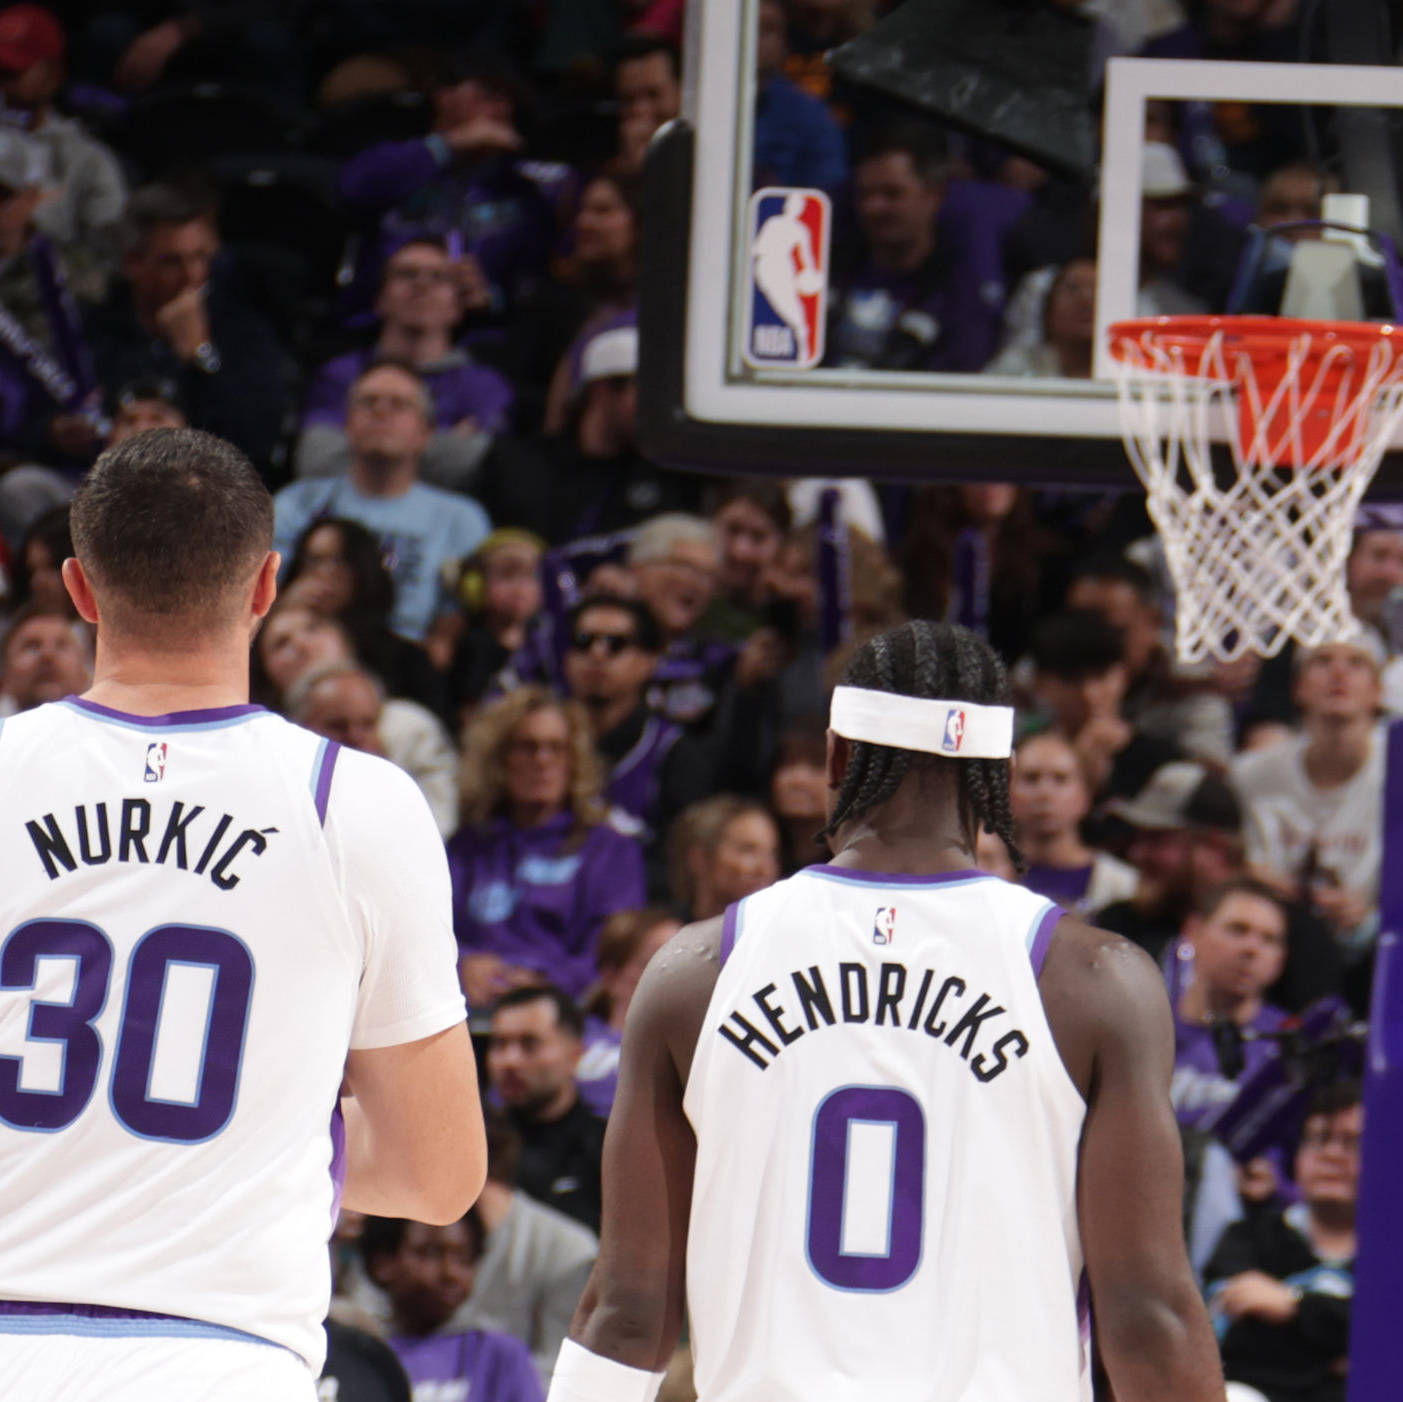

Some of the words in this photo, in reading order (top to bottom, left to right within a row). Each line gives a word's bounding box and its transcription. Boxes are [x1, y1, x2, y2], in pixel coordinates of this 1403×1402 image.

[25, 797, 280, 892] NURKIĆ
[717, 962, 1030, 1084] HENDRICKS
[803, 1082, 928, 1295] 0
